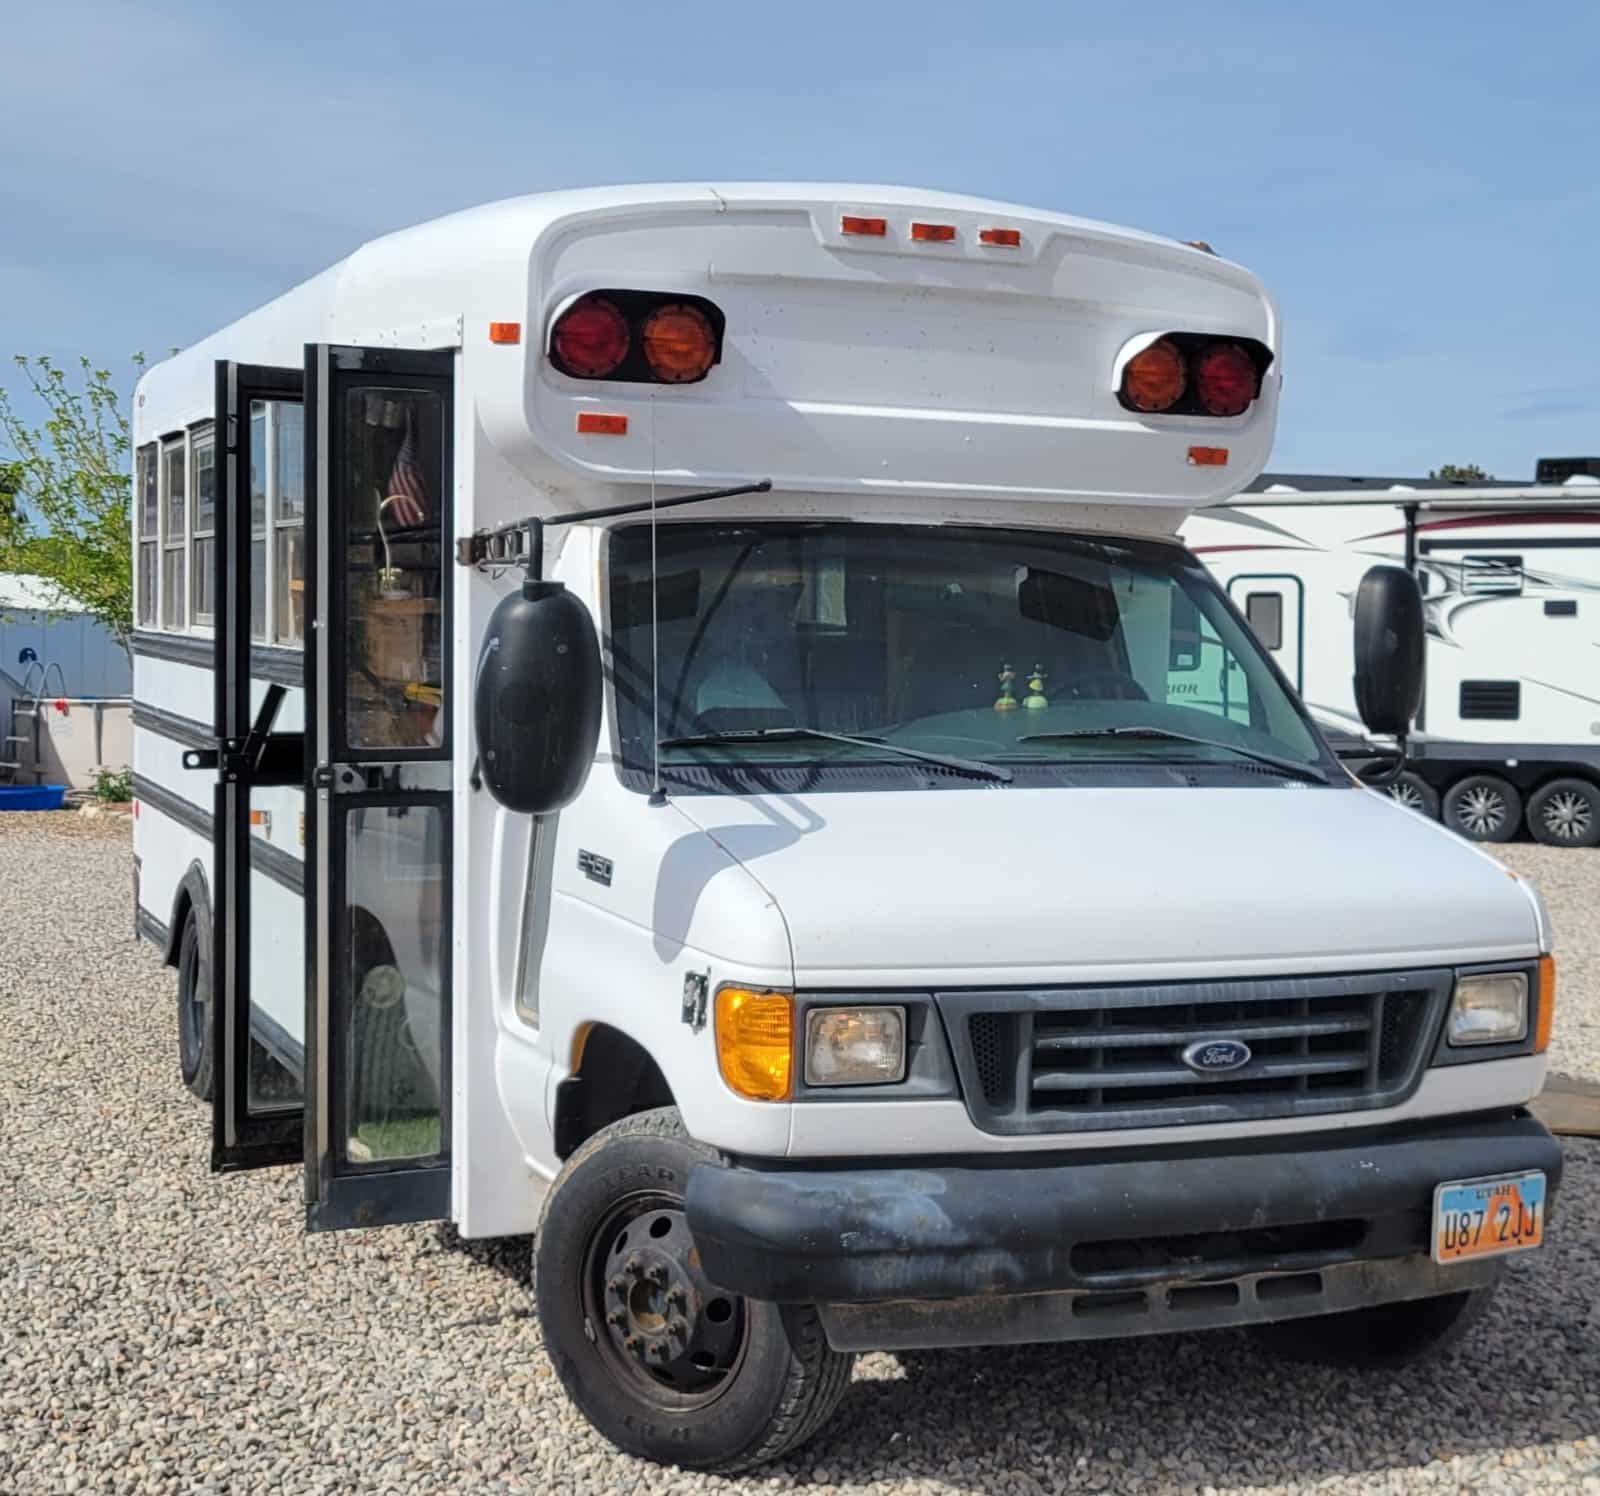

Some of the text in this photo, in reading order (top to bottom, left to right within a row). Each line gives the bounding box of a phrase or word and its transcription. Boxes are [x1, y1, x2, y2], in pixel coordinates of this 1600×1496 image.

[1202, 1047, 1236, 1064] Ford
[1475, 1183, 1511, 1200] UTAH
[1444, 1209, 1484, 1250] U87
